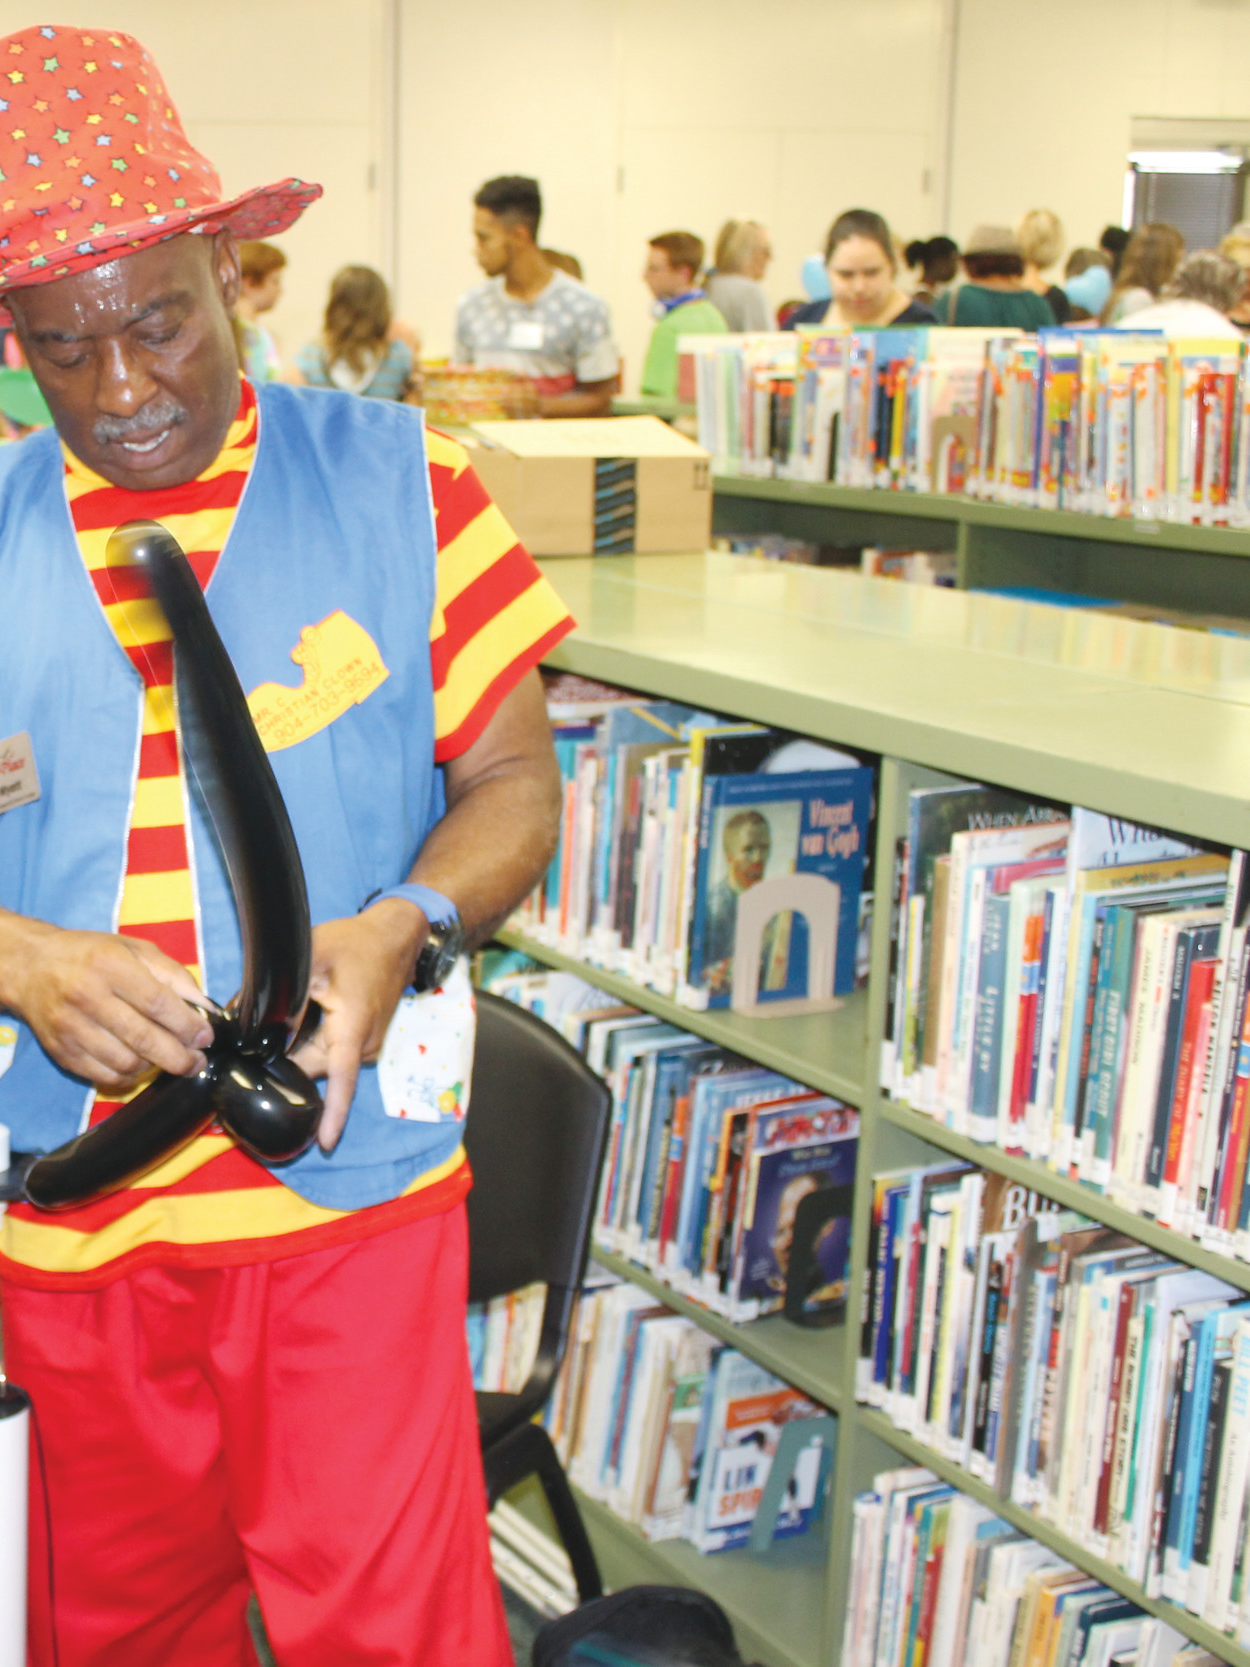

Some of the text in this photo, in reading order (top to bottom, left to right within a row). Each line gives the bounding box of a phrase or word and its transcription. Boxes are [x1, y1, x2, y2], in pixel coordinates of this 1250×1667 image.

[258, 658, 362, 736] CHRISTIAN CLOWN
[808, 797, 855, 828] Vincent
[968, 812, 1019, 832] WHEN
[802, 824, 861, 859] van Gogh
[1106, 989, 1121, 1032] FIRST
[1202, 1036, 1218, 1095] MANDELA
[1097, 1070, 1112, 1118] SCOUT
[1233, 1375, 1250, 1417] PEET
